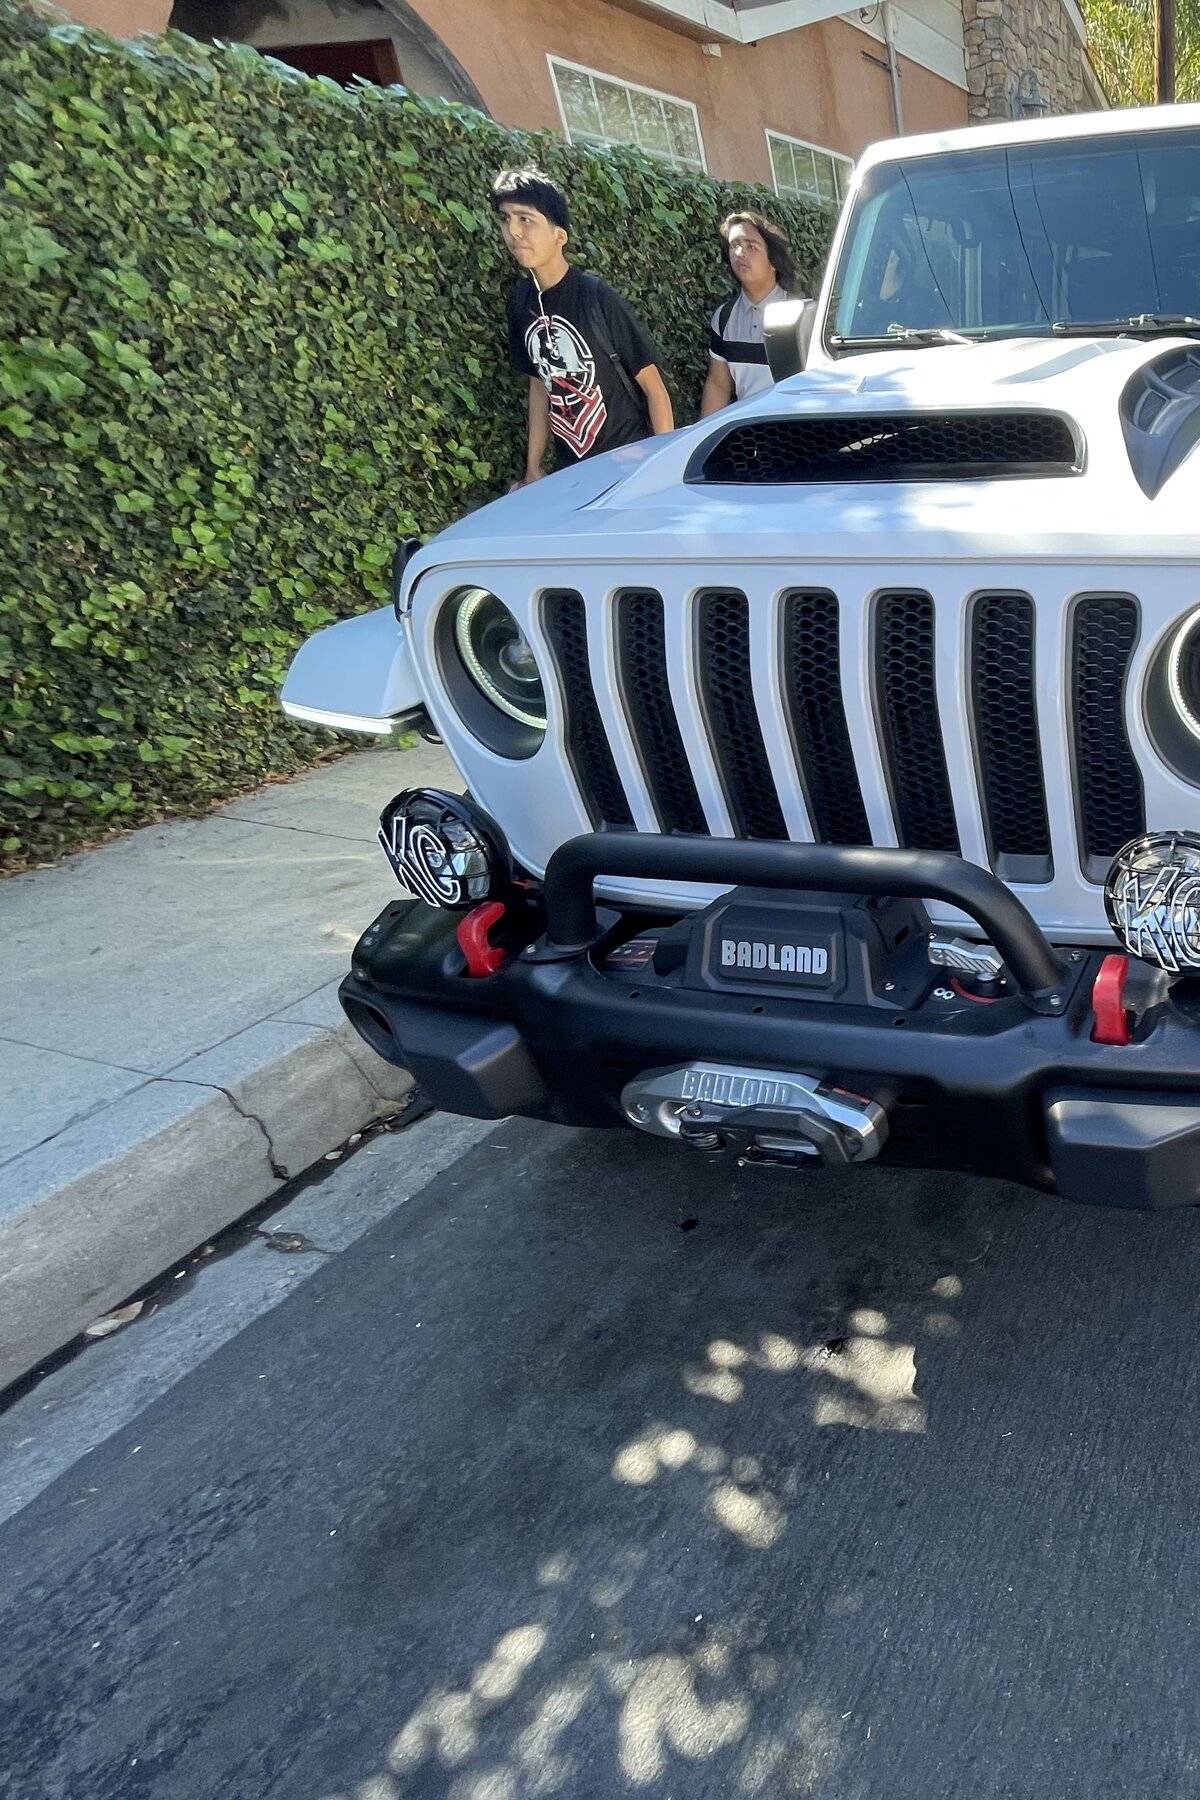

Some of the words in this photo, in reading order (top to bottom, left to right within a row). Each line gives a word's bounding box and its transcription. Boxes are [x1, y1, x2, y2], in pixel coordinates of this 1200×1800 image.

[377, 816, 461, 908] KC
[721, 939, 828, 975] BADLAND
[681, 1070, 791, 1106] BADLAND
